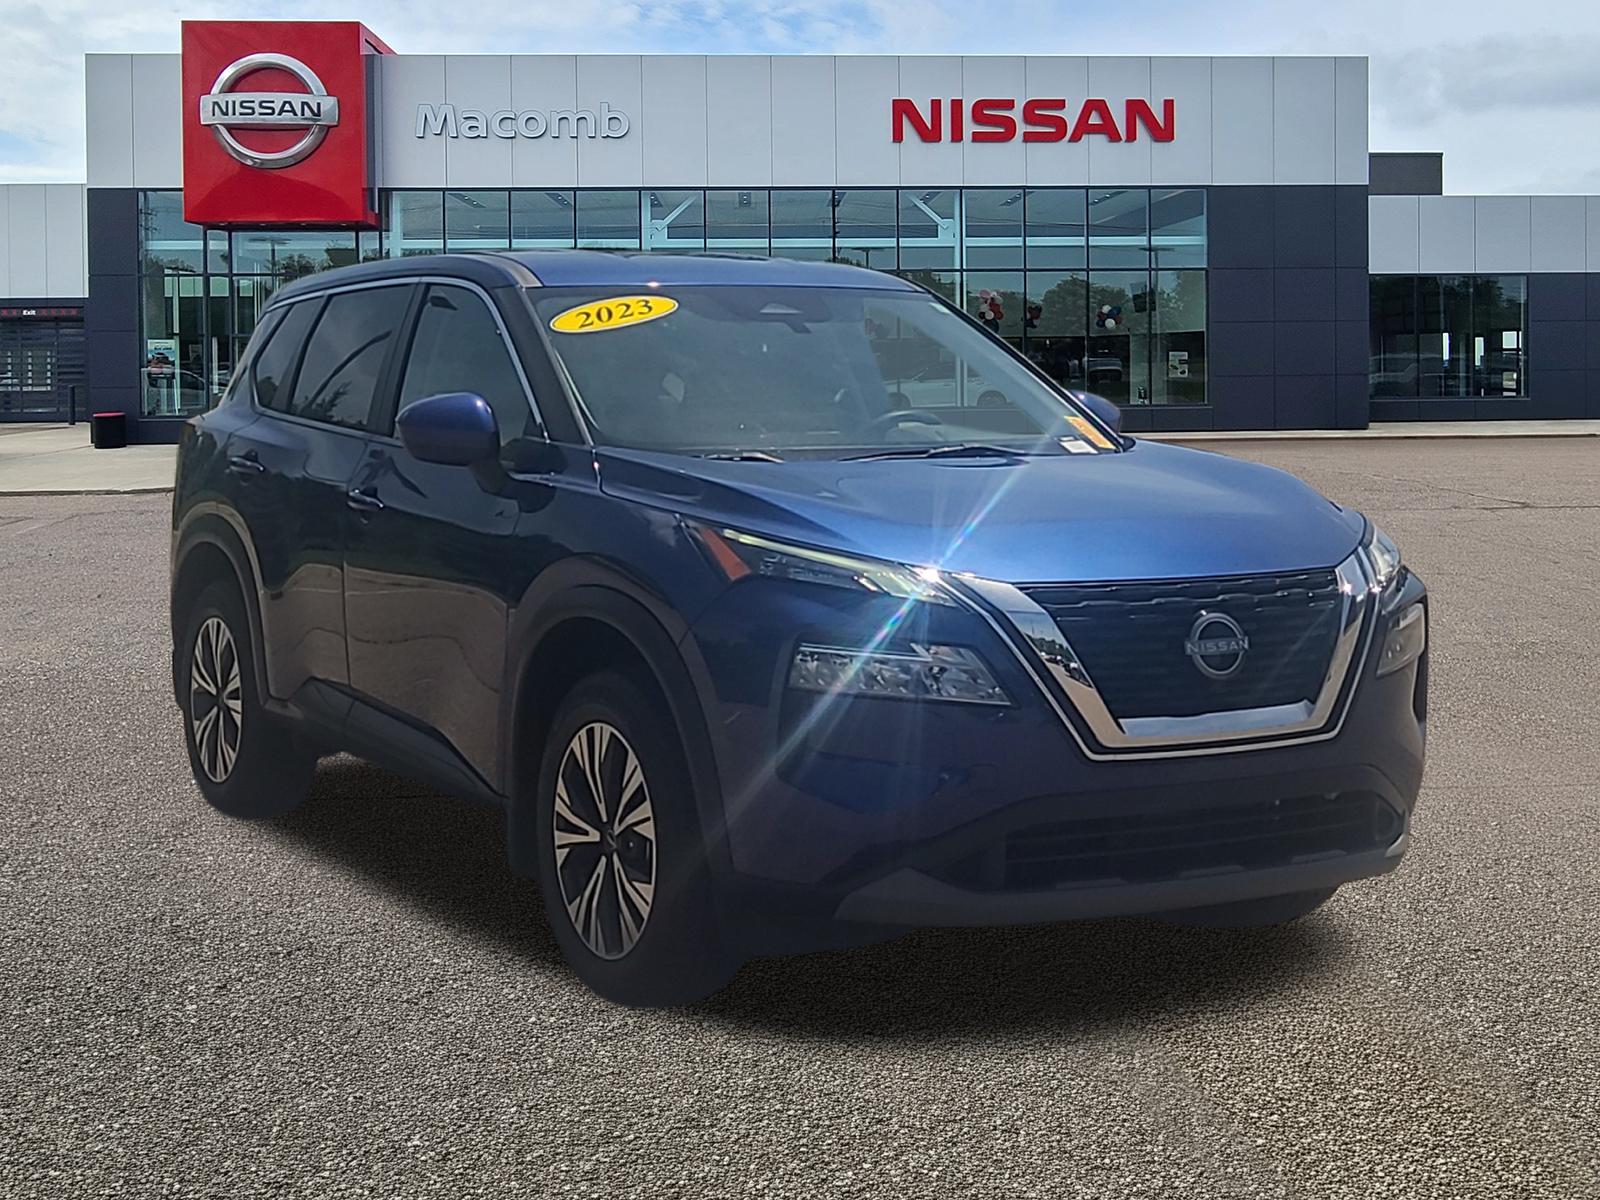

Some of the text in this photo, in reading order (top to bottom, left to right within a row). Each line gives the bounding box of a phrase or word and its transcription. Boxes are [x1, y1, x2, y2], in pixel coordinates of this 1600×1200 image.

[212, 100, 322, 117] NISSAN
[415, 102, 630, 138] Macomb
[892, 99, 1175, 142] NISSAN
[575, 299, 653, 328] 2023
[1186, 636, 1249, 654] NISSAN
